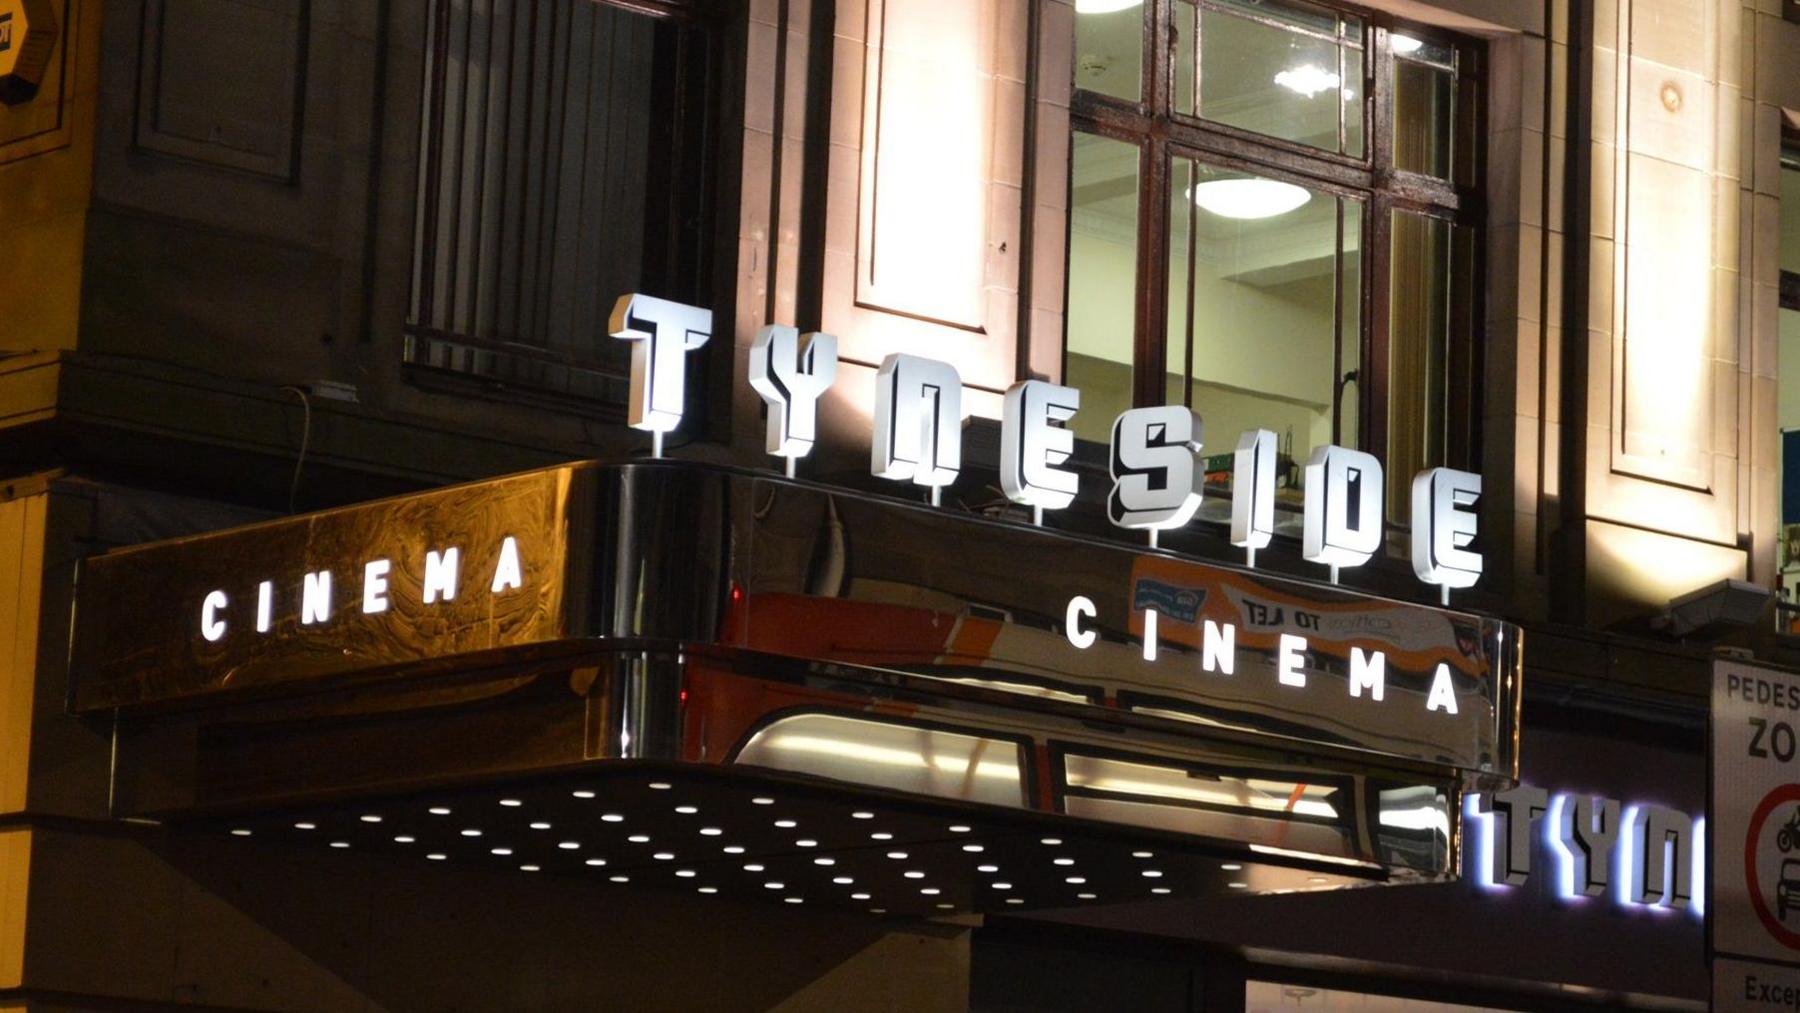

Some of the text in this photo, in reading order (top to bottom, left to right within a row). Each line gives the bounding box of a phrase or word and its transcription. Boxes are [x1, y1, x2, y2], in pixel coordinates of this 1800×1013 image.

[608, 293, 1484, 589] TYNESIDE
[201, 536, 522, 642] CINEMA
[1066, 596, 1459, 714] CINEMA
[1727, 674, 1800, 711] PEDES
[1748, 717, 1796, 763] ZO
[1476, 785, 1706, 909] TYN
